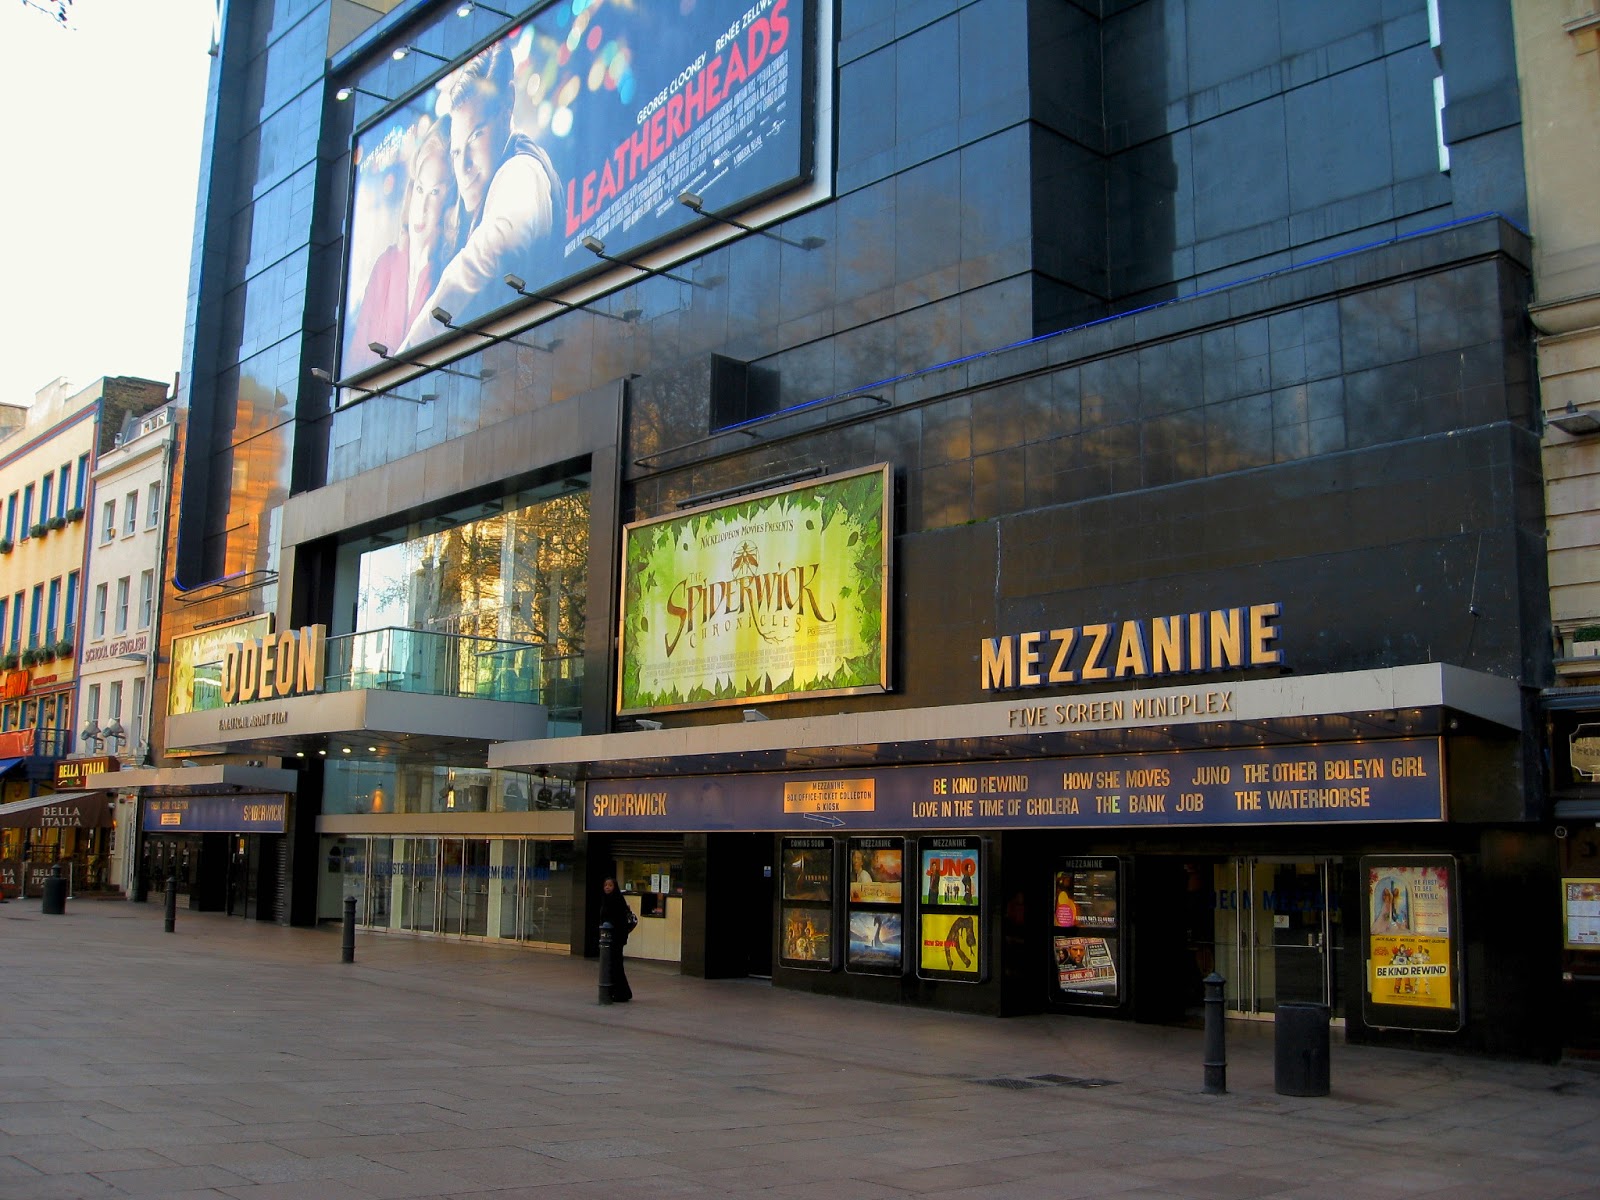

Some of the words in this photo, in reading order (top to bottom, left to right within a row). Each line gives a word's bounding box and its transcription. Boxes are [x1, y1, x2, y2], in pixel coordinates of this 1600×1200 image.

[715, 20, 740, 53] RENÉE
[637, 87, 668, 125] GEORGE
[670, 51, 706, 95] CLOONEY
[565, 0, 789, 238] LEATHERHEADS
[689, 612, 802, 649] CHRONICLES
[86, 645, 109, 663] SCHOOL
[110, 642, 119, 656] OF
[119, 636, 147, 655] ENGLISH
[981, 602, 1282, 690] MEZZANINE
[220, 623, 327, 704] ODEON
[1008, 705, 1048, 728] FIVE
[1055, 699, 1125, 725] SCREEN
[1132, 690, 1233, 719] MINIPLEX
[58, 763, 79, 778] BELLA
[81, 761, 105, 777] ITALIA
[1063, 771, 1095, 791] HOW
[1096, 770, 1121, 789] SHE
[1126, 769, 1171, 789] MOVES
[1192, 765, 1231, 786] JUNO
[1243, 763, 1270, 784] THE
[1272, 761, 1318, 783] OTHER
[1324, 757, 1385, 781] BOLEYN
[1391, 756, 1427, 778] GIRL
[812, 781, 845, 790] MEZZANINE
[932, 778, 948, 795] BE
[952, 776, 978, 795] KIND
[981, 775, 1029, 793] REWIND
[592, 792, 668, 817] SPIDERWICK
[822, 802, 840, 811] KIOSK
[912, 801, 939, 818] LOVE
[941, 801, 952, 818] IN
[954, 800, 974, 817] THE
[979, 799, 1004, 817] TIME
[1007, 798, 1022, 816] OF
[1026, 797, 1080, 816] CHOLERA
[1096, 795, 1121, 814] THE
[1129, 794, 1166, 813] BANK
[1175, 793, 1205, 812] JOB
[1235, 791, 1262, 811] THE
[1266, 787, 1370, 809] WATERHORSE
[43, 806, 81, 816] BELLA
[243, 804, 283, 822] SPIDERWICK
[41, 817, 82, 827] ITALIA
[932, 838, 967, 848] MEZZANINE
[33, 868, 55, 876] BELL
[925, 857, 977, 877] JUNO
[1066, 859, 1104, 869] MEZZANINE
[1376, 967, 1387, 976] BE
[1388, 966, 1409, 976] KIND
[1410, 965, 1447, 975] REWIND
